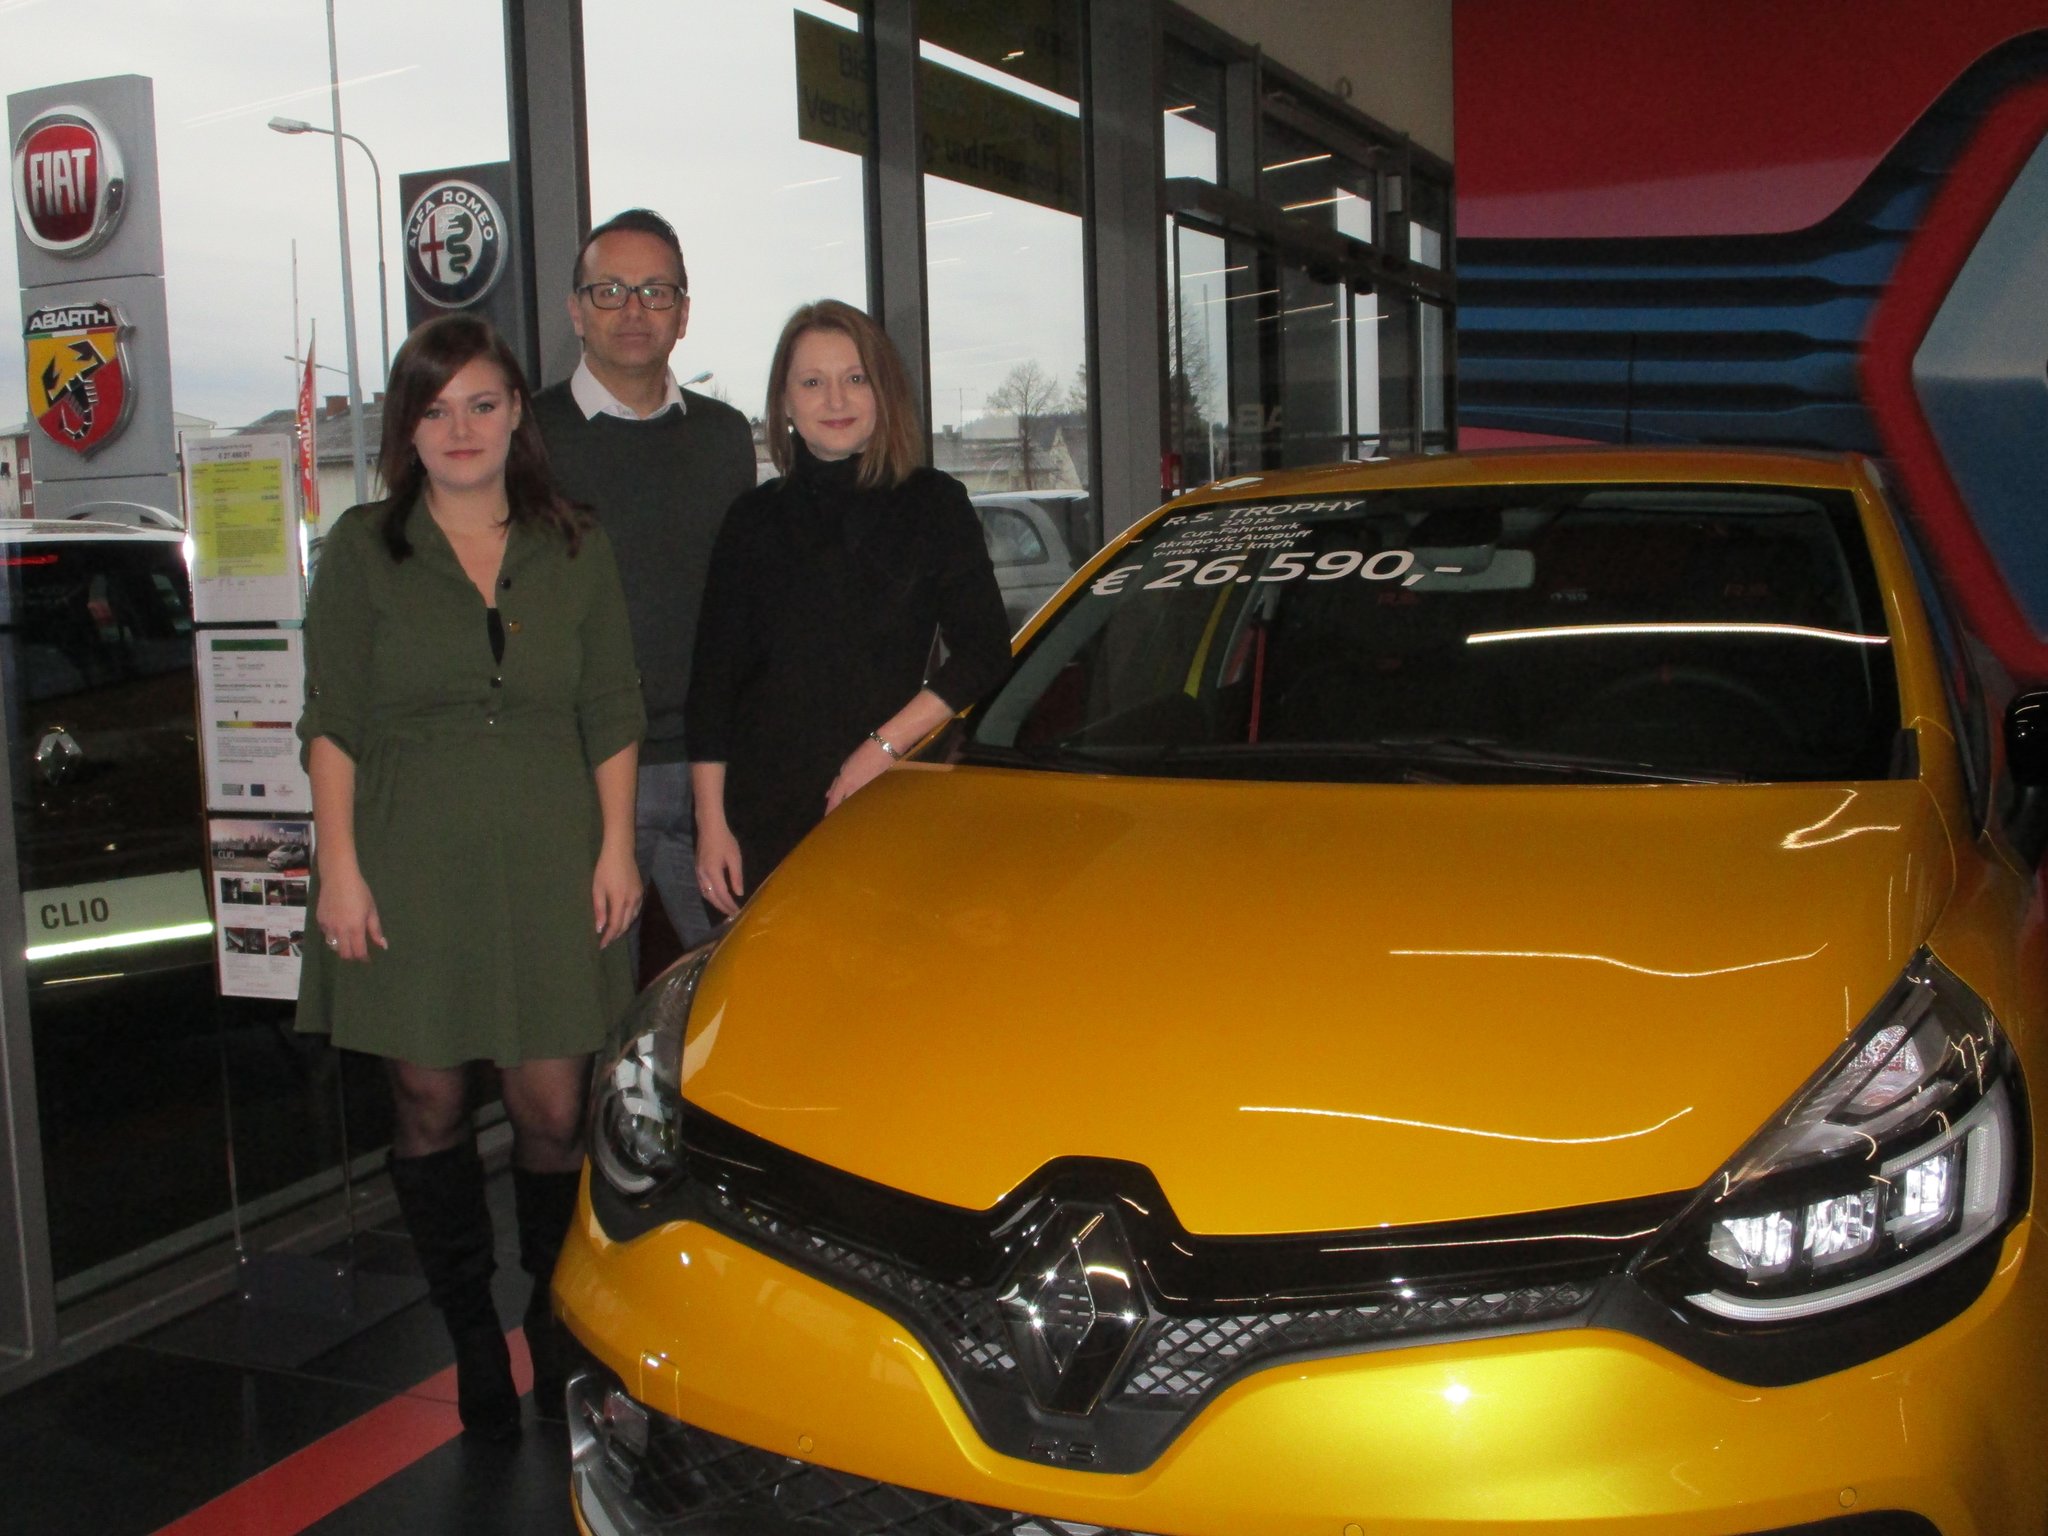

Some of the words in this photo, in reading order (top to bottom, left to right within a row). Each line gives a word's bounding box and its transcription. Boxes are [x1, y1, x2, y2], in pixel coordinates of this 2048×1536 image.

[30, 148, 92, 217] FIAT
[409, 200, 436, 249] ALFA
[442, 190, 494, 241] ROMEO
[29, 310, 109, 331] ABARTH
[1162, 512, 1214, 527] R.S.
[1228, 500, 1366, 519] TROPHY
[1219, 518, 1252, 527] 220
[1253, 516, 1277, 526] ps
[1153, 535, 1238, 550] Akrapovic
[1240, 529, 1313, 542] Auspuff
[1181, 522, 1301, 539] Cup-Fahrwerk
[1152, 546, 1208, 559] v-max:
[1210, 542, 1246, 553] 235
[1246, 540, 1295, 551] km/h
[1091, 564, 1144, 595] €
[1143, 550, 1462, 589] 26.590,-
[40, 897, 110, 930] CLIO
